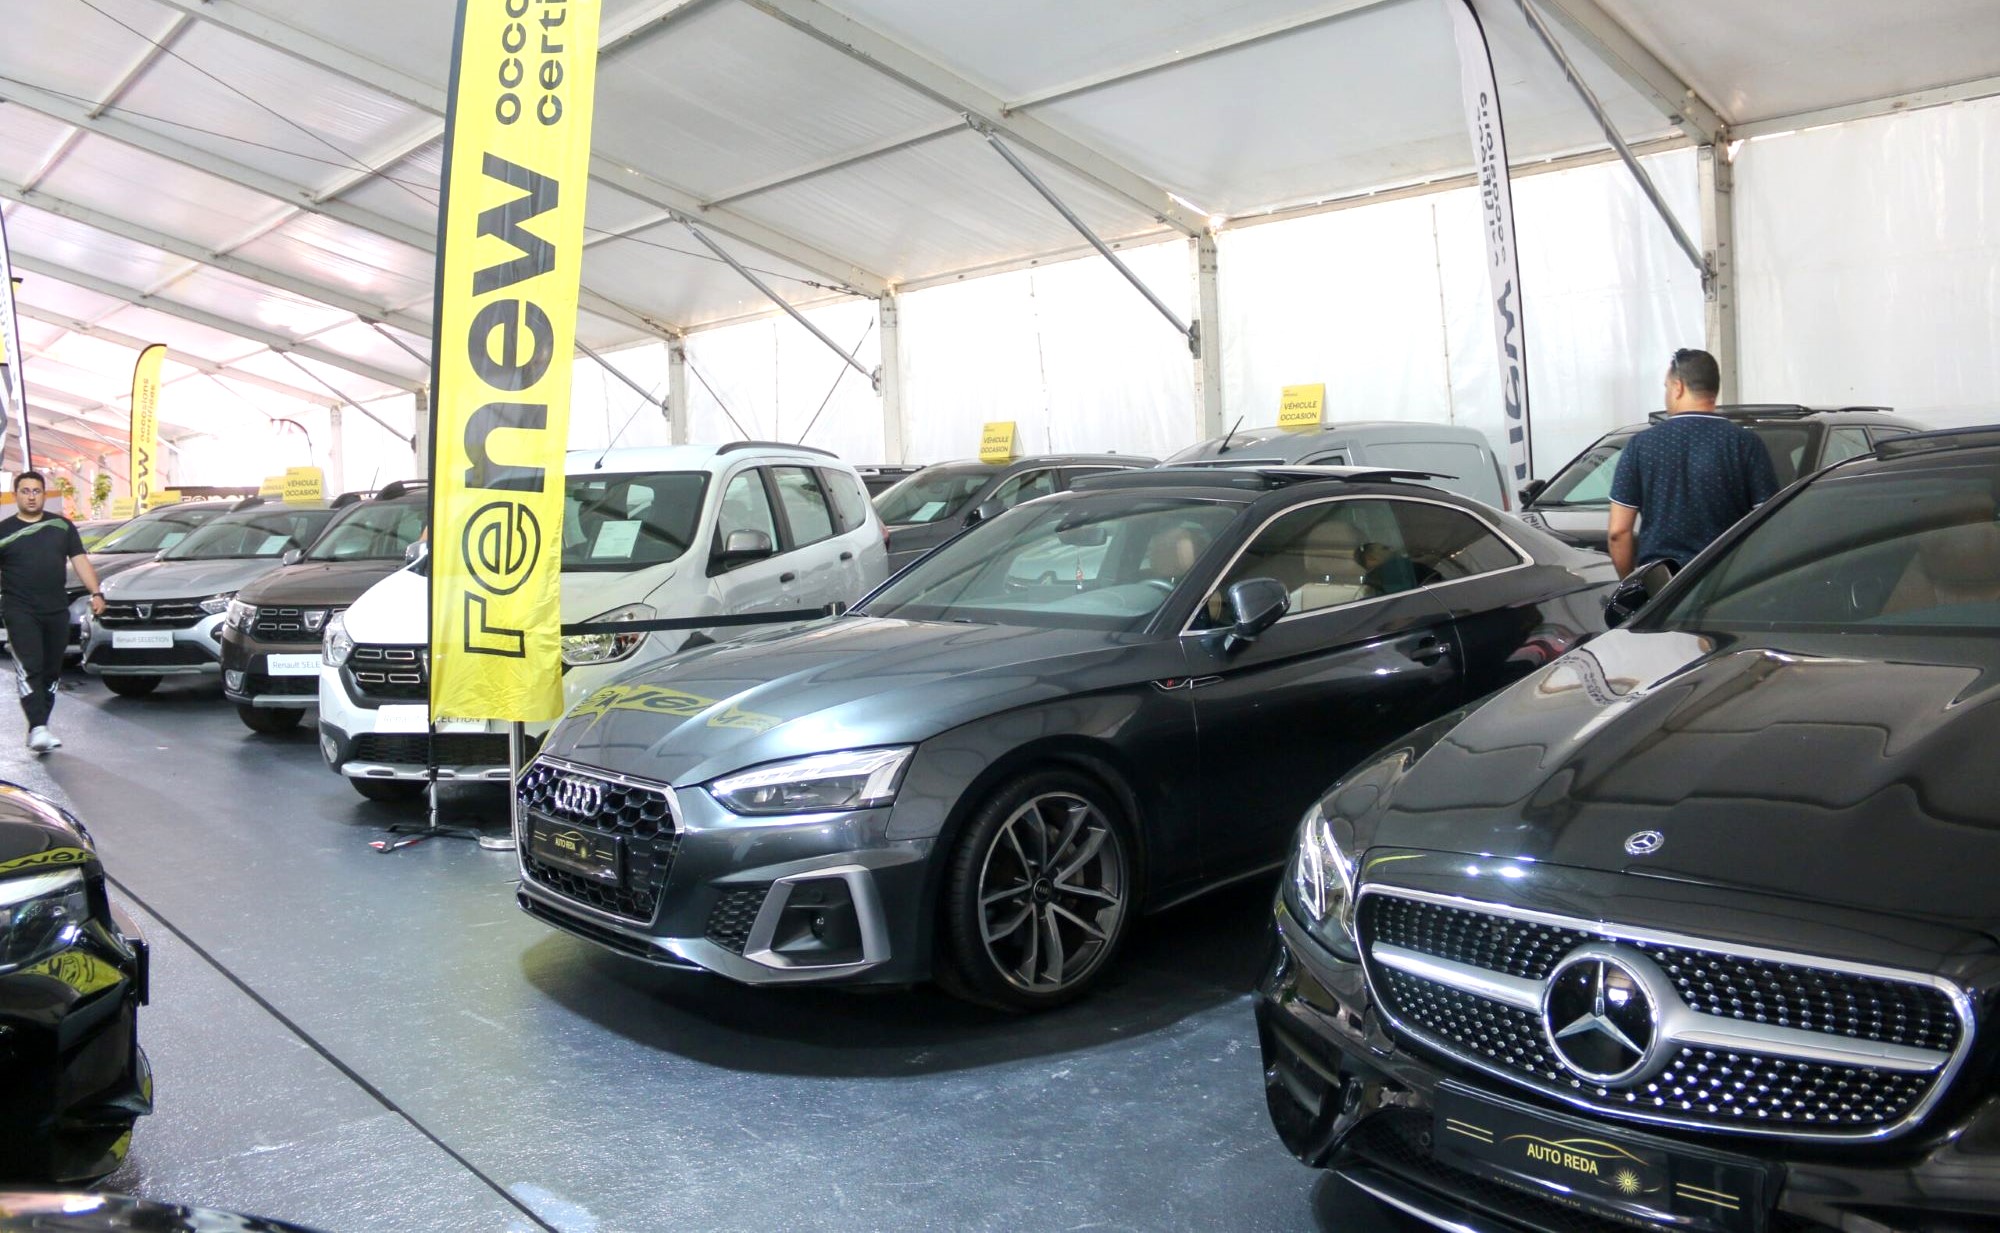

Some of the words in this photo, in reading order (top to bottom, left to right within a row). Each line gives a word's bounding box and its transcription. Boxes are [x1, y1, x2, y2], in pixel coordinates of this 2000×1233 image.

[462, 151, 560, 659] renew
[1280, 412, 1318, 421] OCCASION
[980, 446, 1009, 454] OCCASION
[285, 489, 320, 497] OCCASION
[272, 661, 300, 669] Renault
[1527, 1143, 1561, 1164] AUTO
[1564, 1153, 1599, 1176] REDA
